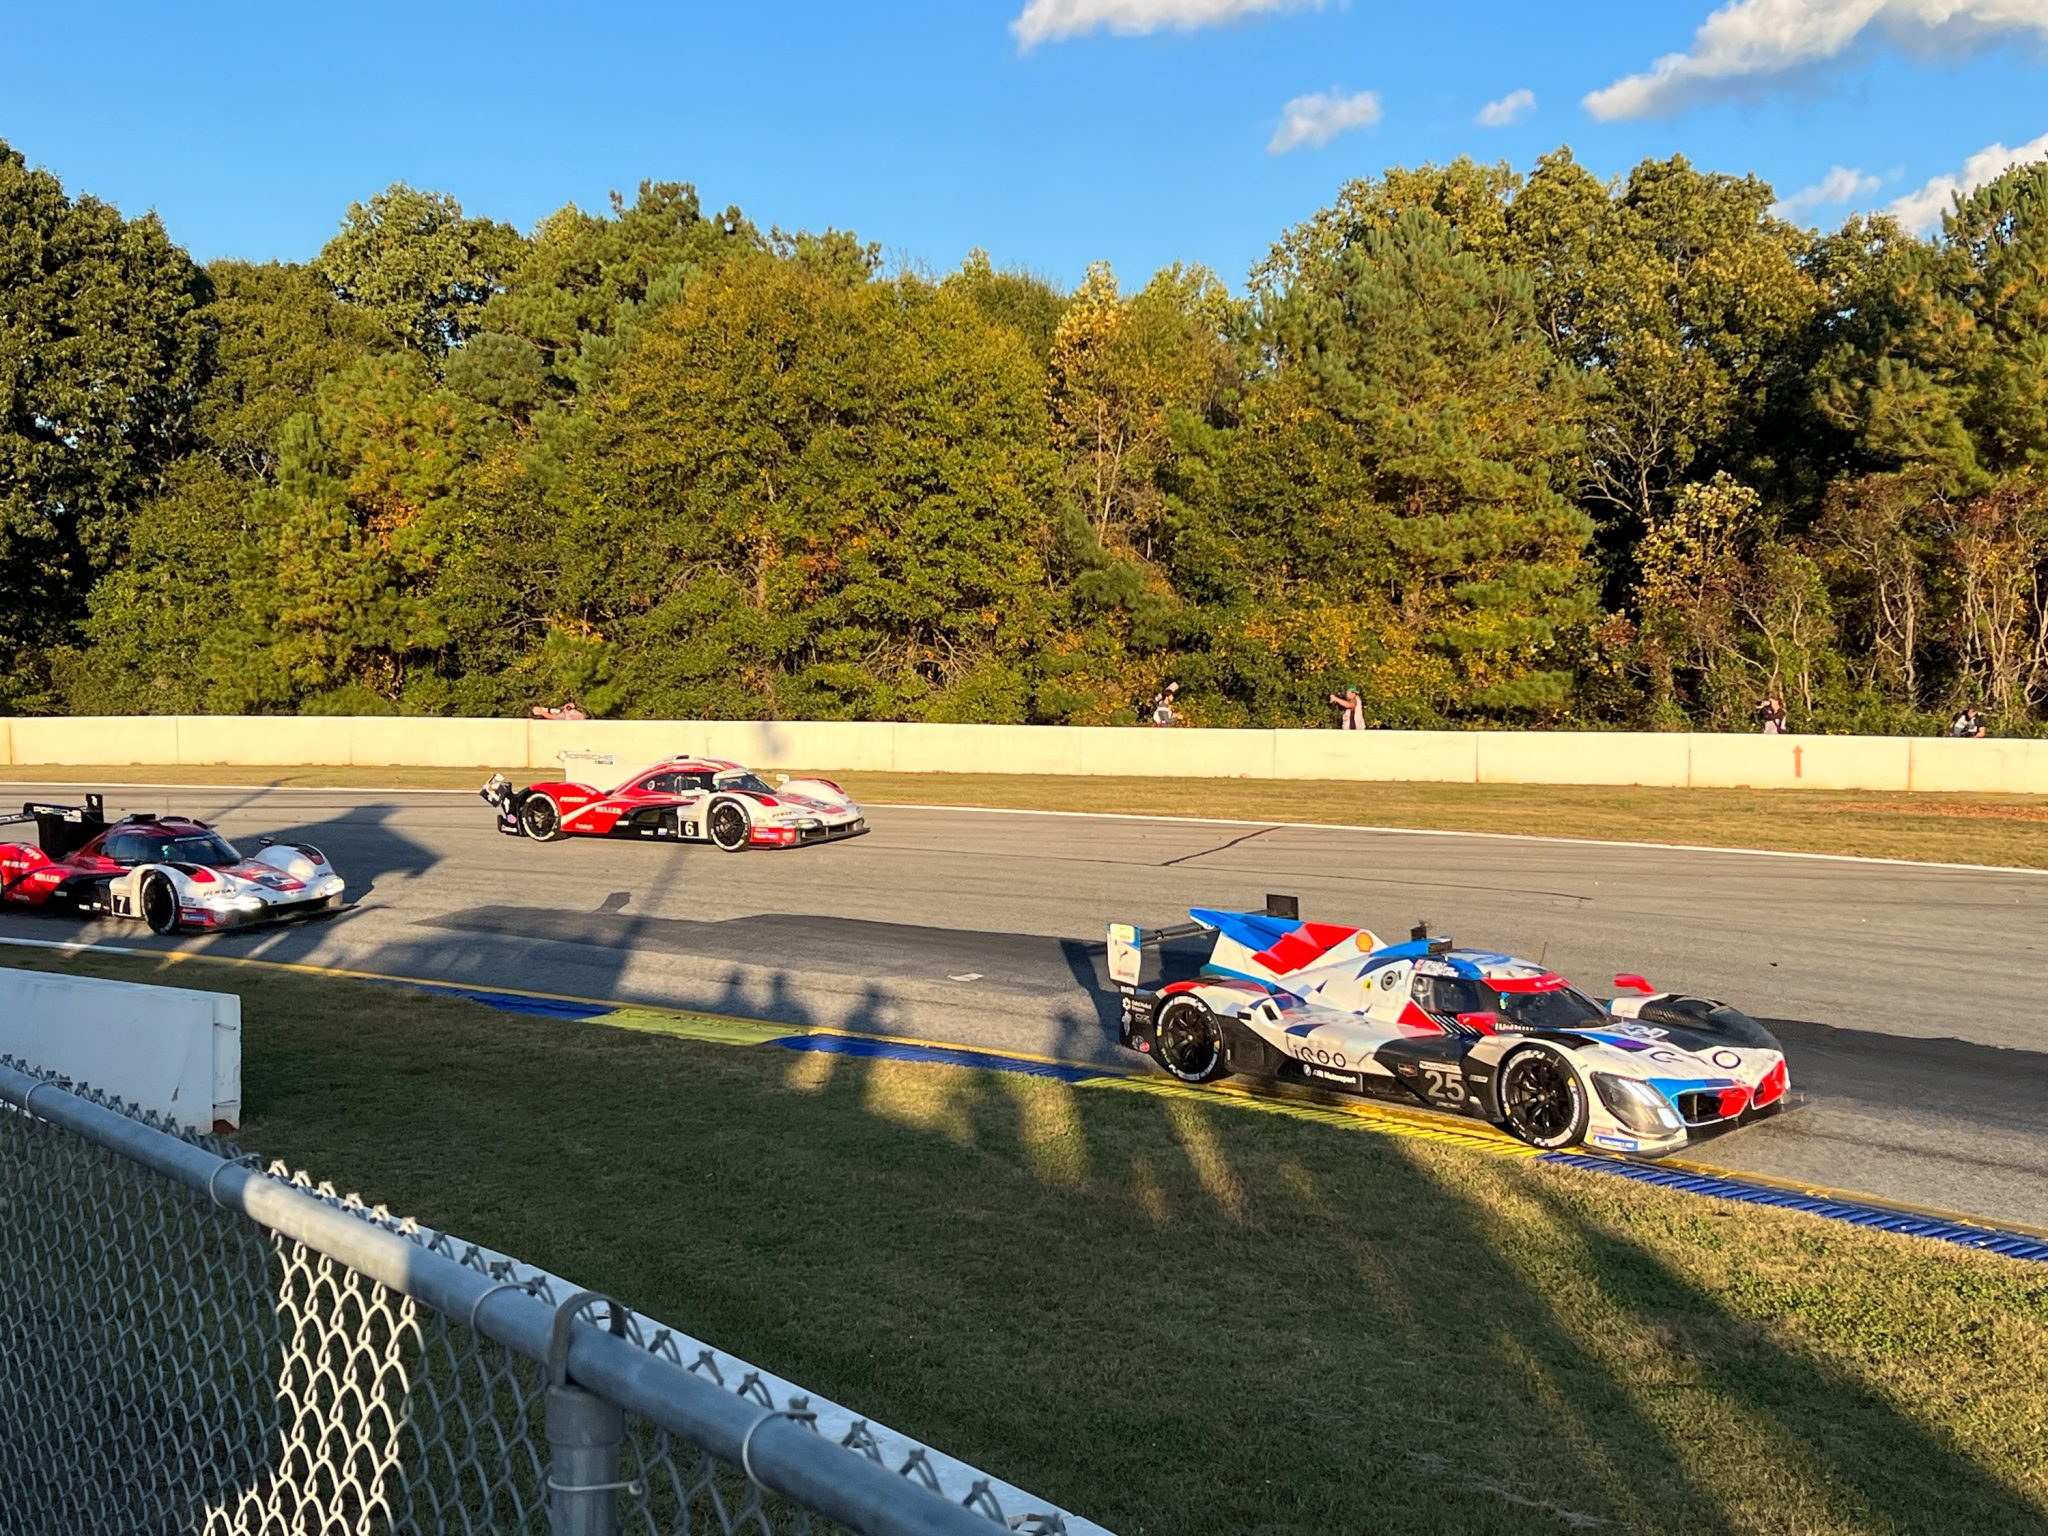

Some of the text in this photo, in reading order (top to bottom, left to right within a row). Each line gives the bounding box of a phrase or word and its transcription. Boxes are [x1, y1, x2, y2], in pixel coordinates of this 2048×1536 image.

[685, 821, 695, 836] 6
[116, 896, 127, 913] 7
[1424, 1070, 1466, 1102] 25
